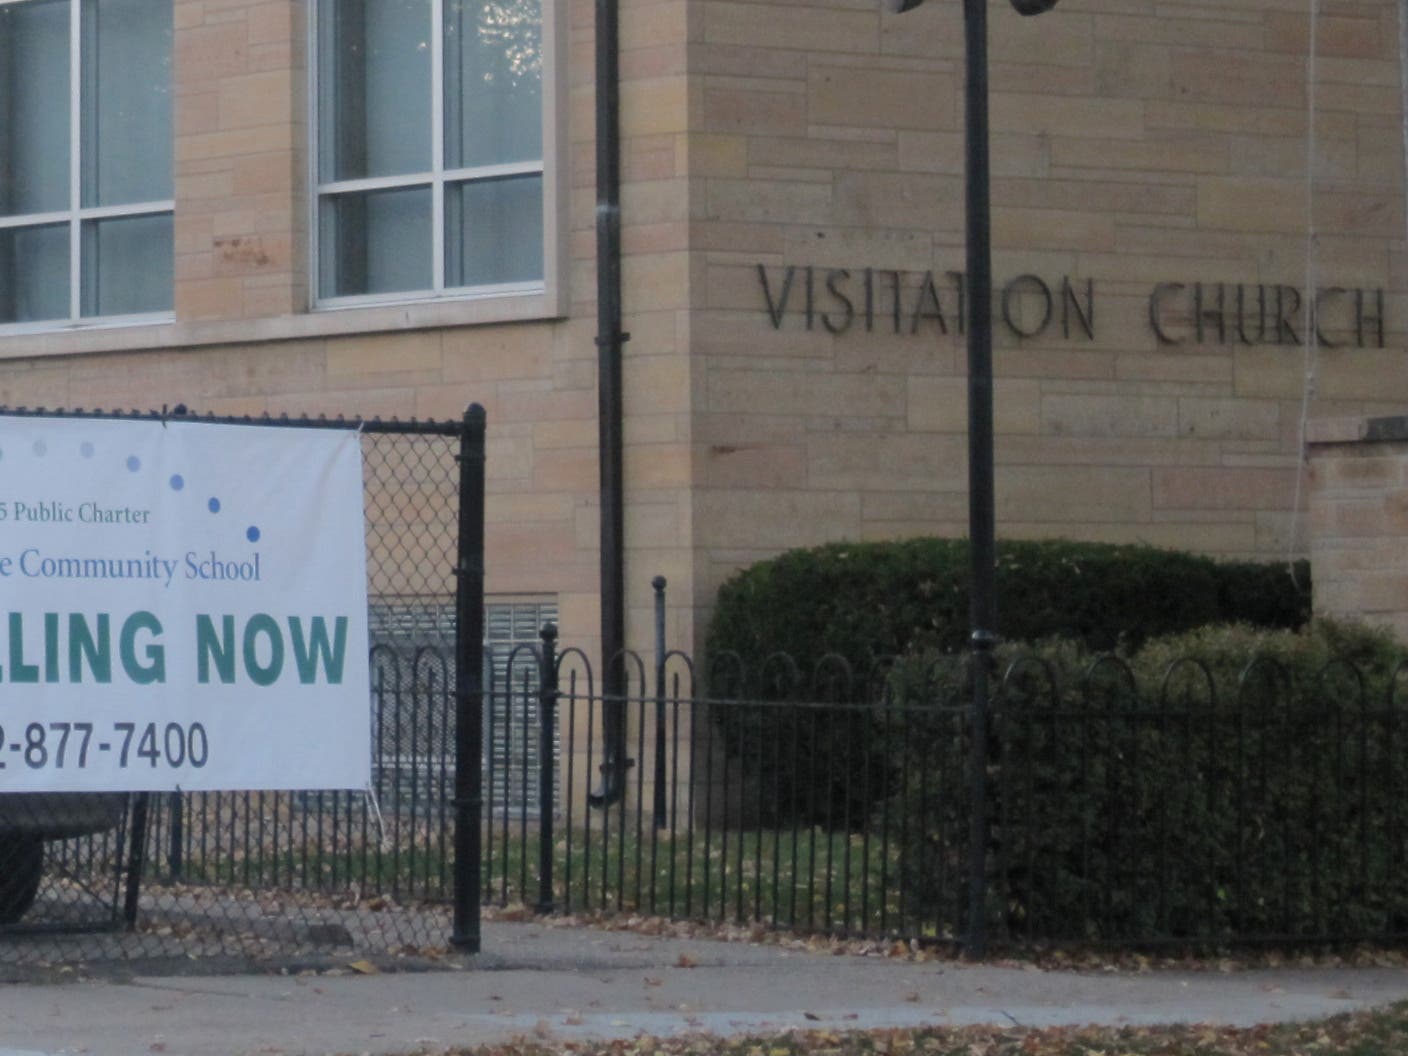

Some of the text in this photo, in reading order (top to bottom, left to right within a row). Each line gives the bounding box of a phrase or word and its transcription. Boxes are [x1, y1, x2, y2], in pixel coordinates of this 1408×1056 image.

[757, 262, 1385, 348] VISITATON CHURCH
[13, 500, 73, 523] Public
[78, 502, 151, 524] Charter
[19, 549, 178, 587] Community
[184, 550, 261, 581] School
[196, 613, 349, 687] NOW
